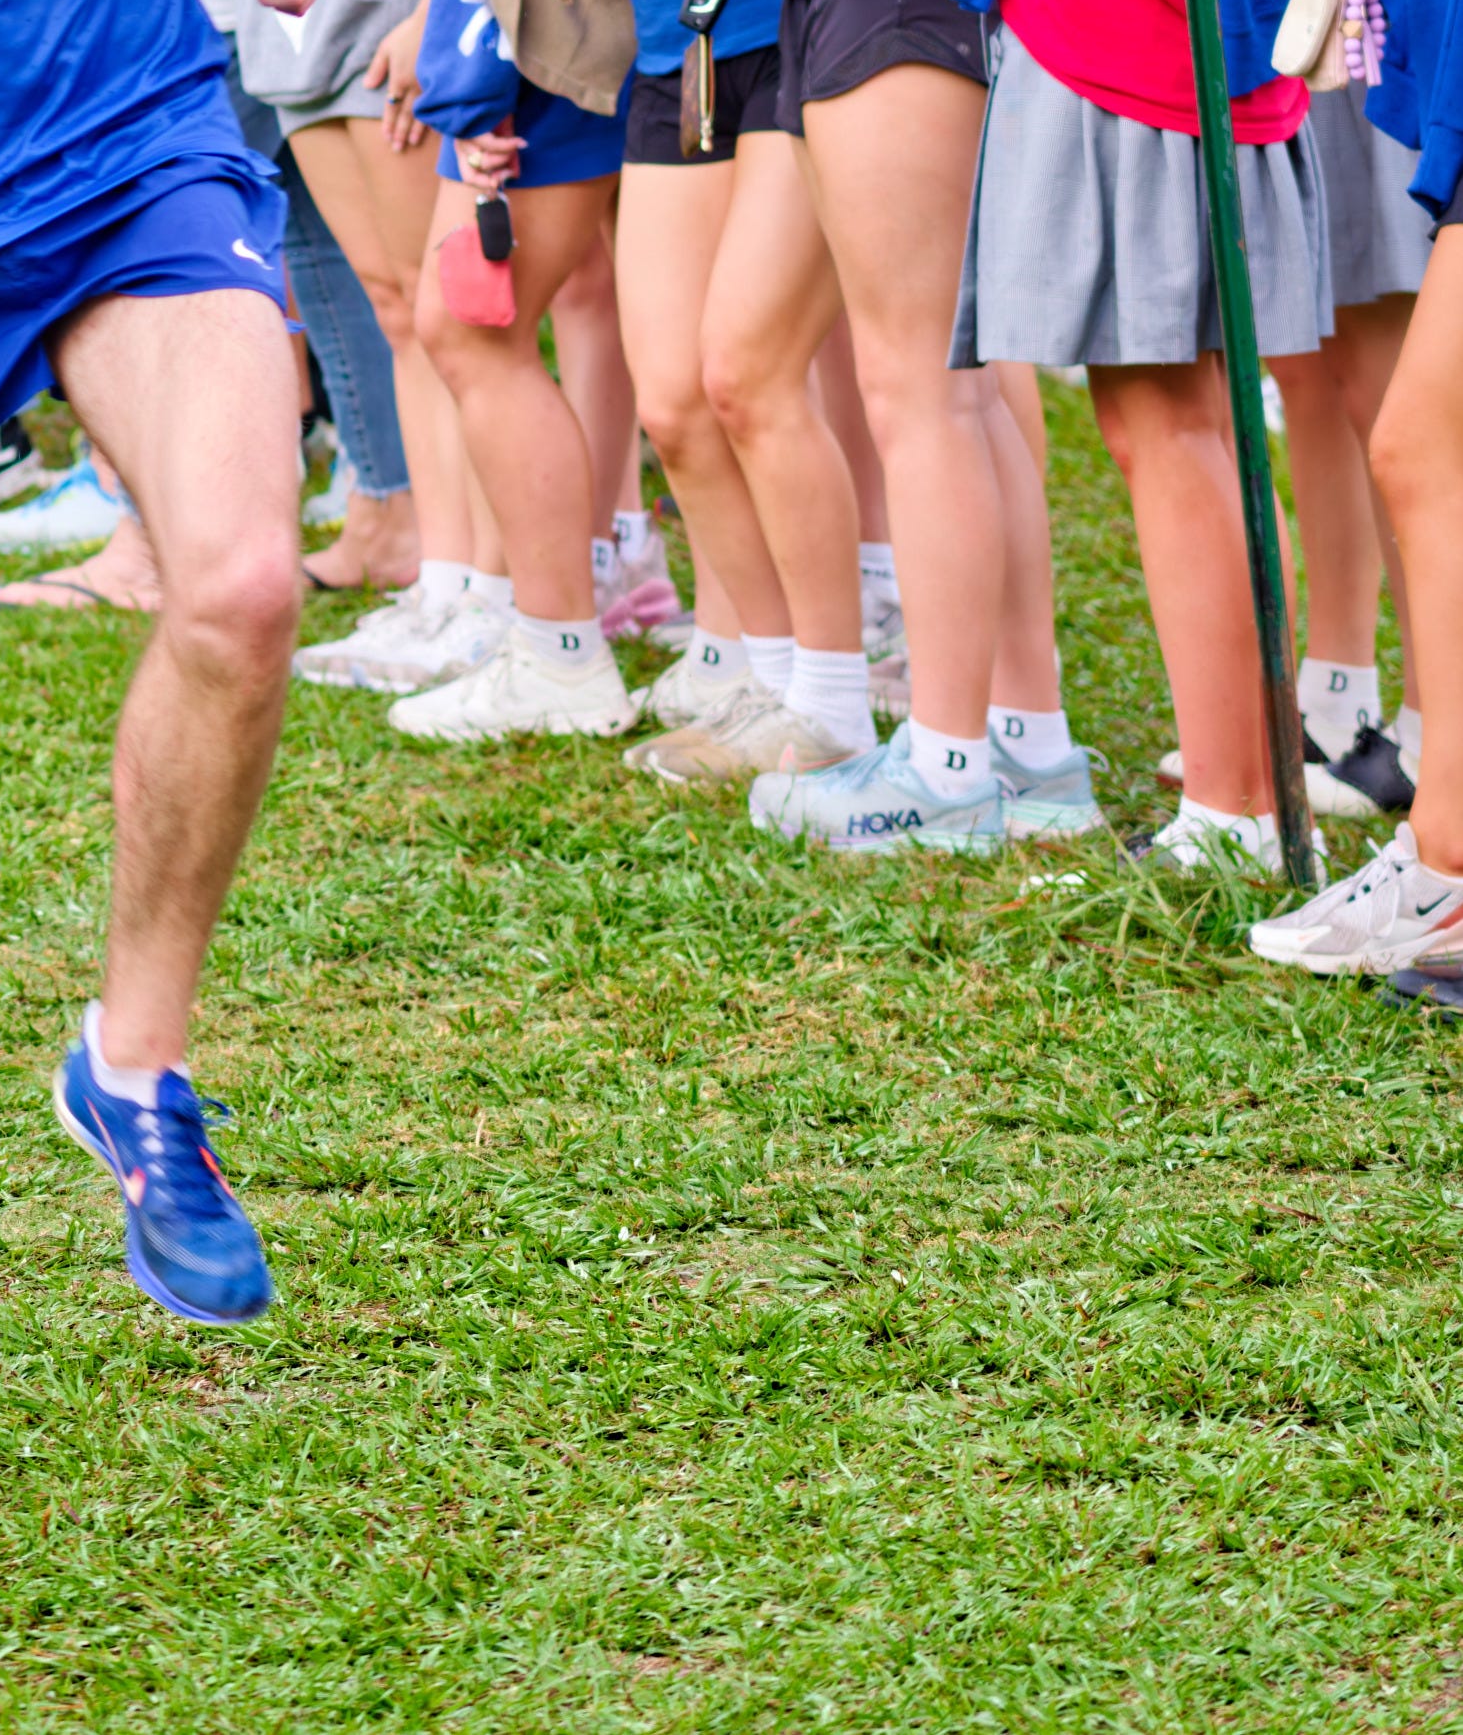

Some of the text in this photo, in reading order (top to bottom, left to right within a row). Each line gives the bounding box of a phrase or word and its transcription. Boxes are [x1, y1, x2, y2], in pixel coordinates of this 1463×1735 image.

[559, 632, 580, 652] D
[702, 644, 720, 666] D
[1327, 669, 1348, 694] D
[1004, 716, 1024, 739] D
[945, 749, 967, 771] D
[848, 809, 923, 835] HOKA
